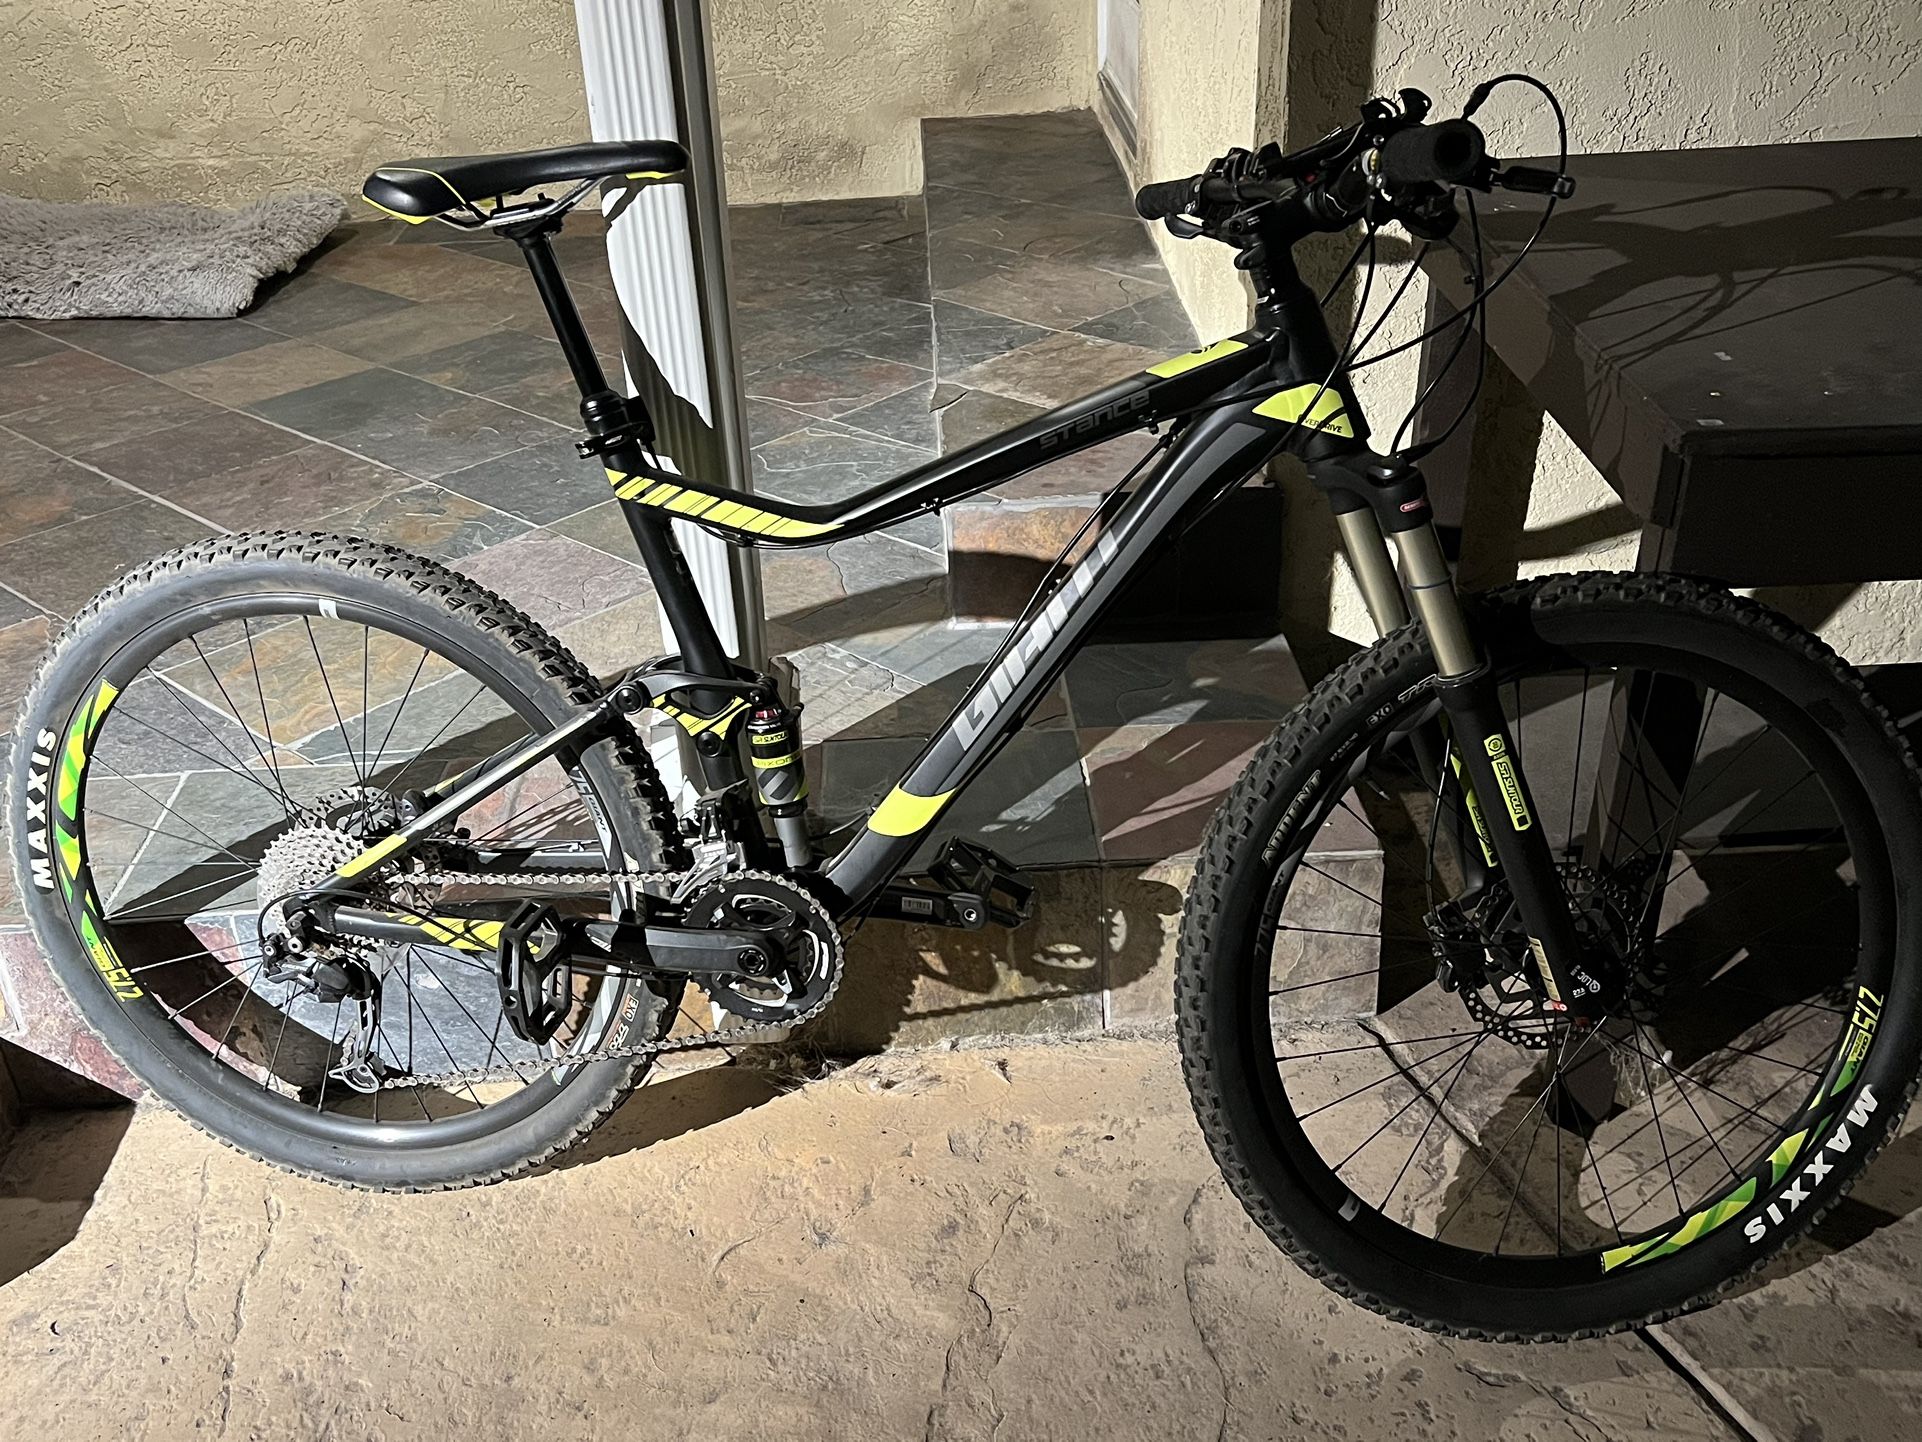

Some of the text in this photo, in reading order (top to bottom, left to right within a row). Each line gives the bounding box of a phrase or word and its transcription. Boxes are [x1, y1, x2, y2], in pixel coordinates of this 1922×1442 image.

[1299, 414, 1342, 434] VERRIVE
[1368, 703, 1391, 724] EXO
[26, 728, 57, 889] MAXXIS
[589, 797, 608, 833] GIANT
[1263, 770, 1321, 867] ARDENT
[102, 968, 144, 1002] 27.5
[624, 998, 638, 1020] EXO
[1852, 986, 1885, 1033] 27.5
[1850, 1035, 1869, 1075] GIANT
[1744, 1084, 1878, 1244] MAXXIS
